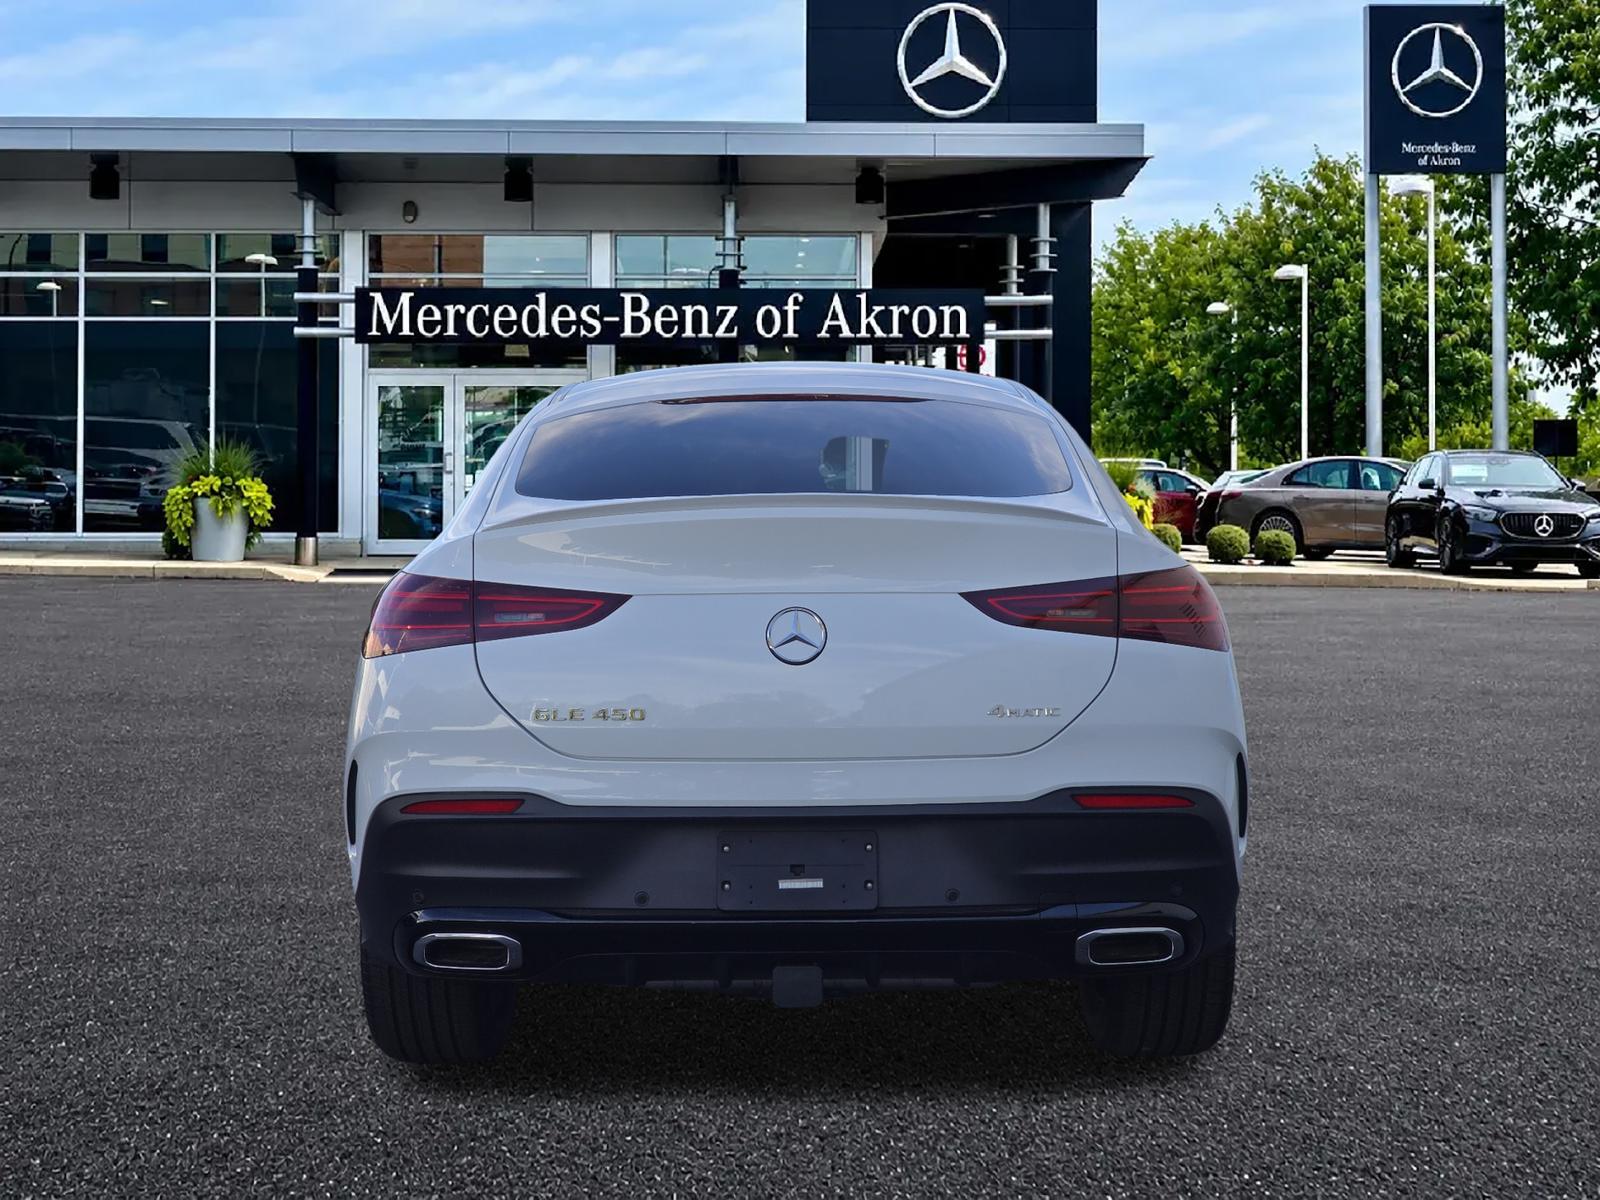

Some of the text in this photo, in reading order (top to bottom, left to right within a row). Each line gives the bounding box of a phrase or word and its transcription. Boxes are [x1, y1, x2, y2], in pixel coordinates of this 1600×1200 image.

[1401, 141, 1477, 154] Mercedes-Benz
[1417, 154, 1461, 166] of Akron
[367, 291, 970, 339] Mercedes-Benz of Akron
[533, 707, 646, 721] GLE 450
[986, 704, 1062, 718] 4MATIC
